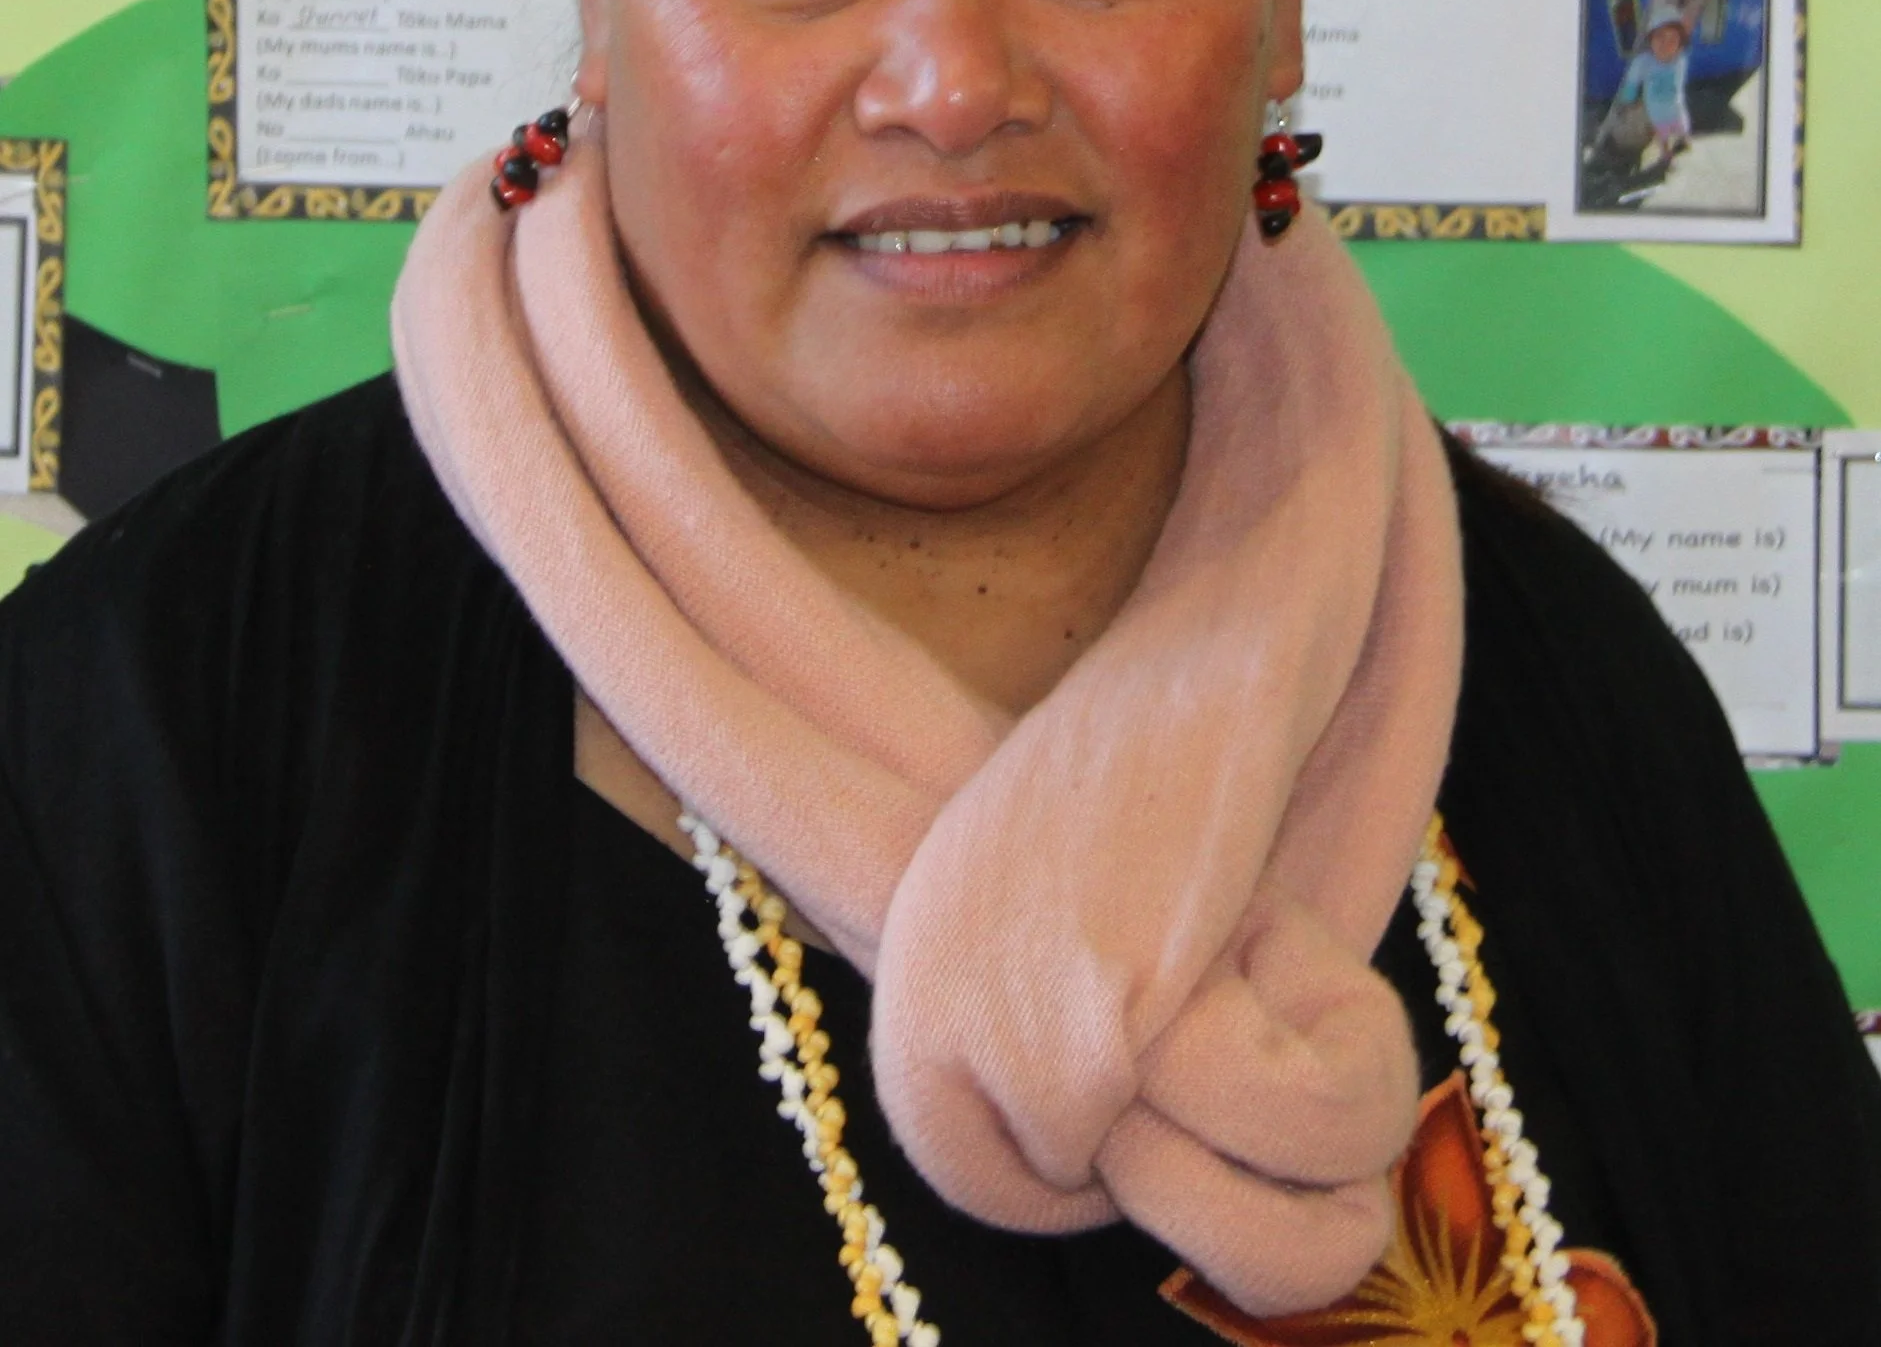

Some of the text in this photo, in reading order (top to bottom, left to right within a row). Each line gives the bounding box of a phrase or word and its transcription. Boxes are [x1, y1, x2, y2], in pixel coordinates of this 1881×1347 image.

[256, 8, 281, 28] Ko
[445, 11, 509, 32] Mama
[256, 36, 294, 59] (My
[299, 39, 360, 58] mums
[363, 40, 417, 58] name
[256, 64, 282, 83] Ko
[445, 66, 494, 89] Papa
[256, 90, 296, 114] (My
[299, 92, 347, 112] dads
[348, 97, 402, 113] name
[1307, 82, 1346, 101] apa
[256, 119, 286, 138] No
[1600, 524, 1786, 553] (My name is)
[1671, 575, 1738, 596] mum
[1751, 572, 1782, 599] is)
[1722, 618, 1755, 645] is)
